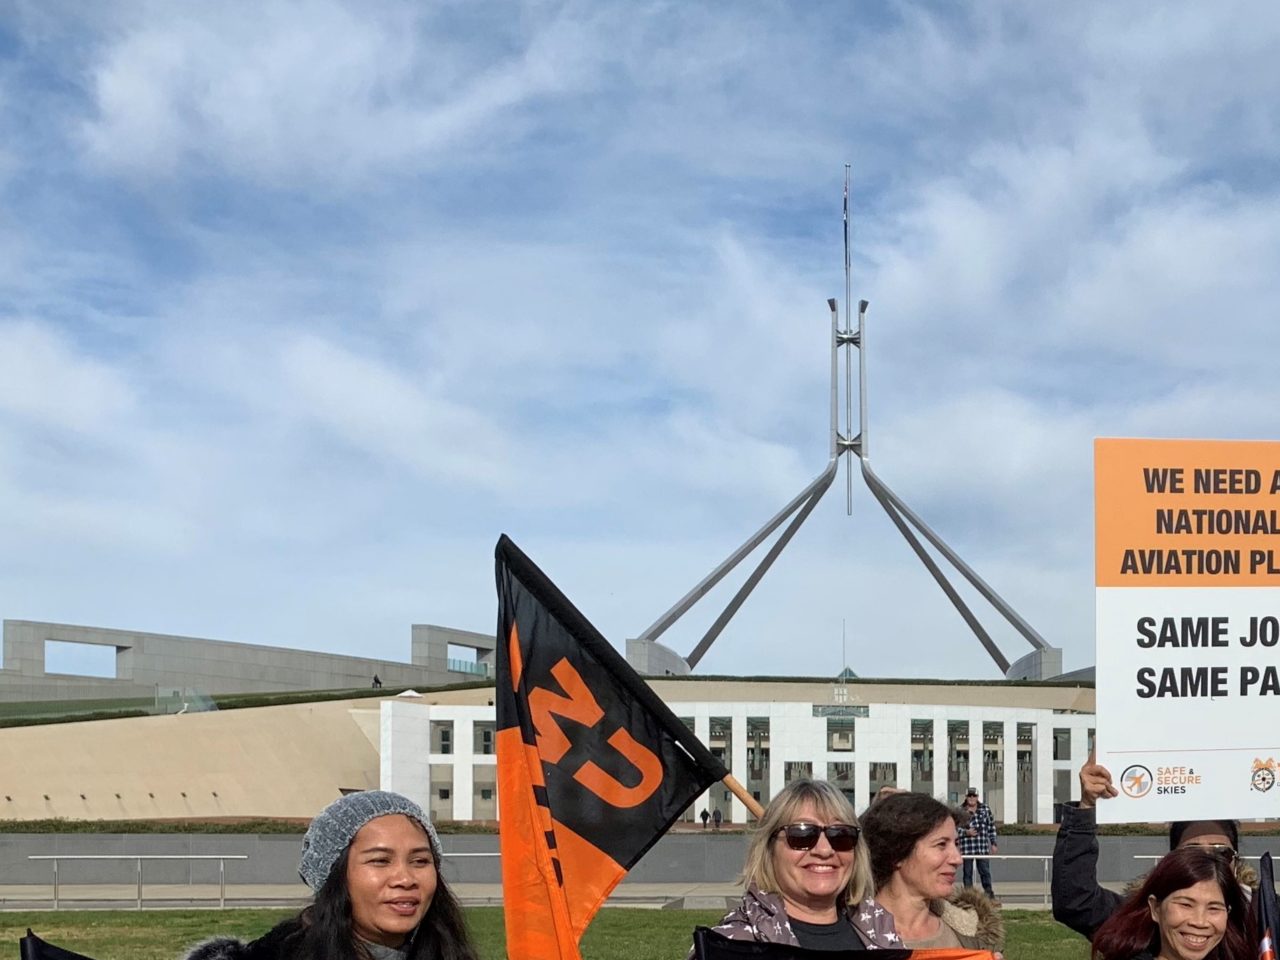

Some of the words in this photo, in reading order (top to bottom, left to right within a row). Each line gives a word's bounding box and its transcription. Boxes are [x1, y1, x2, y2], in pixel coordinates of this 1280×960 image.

[1143, 468, 1184, 493] WE
[1194, 469, 1261, 495] NEED
[1120, 549, 1241, 574] AVIATION
[1136, 616, 1229, 648] SAME
[1136, 667, 1228, 699] SAME
[1157, 766, 1186, 776] SAFE
[1157, 775, 1201, 785] SECURE
[1157, 786, 1186, 795] SKIES
